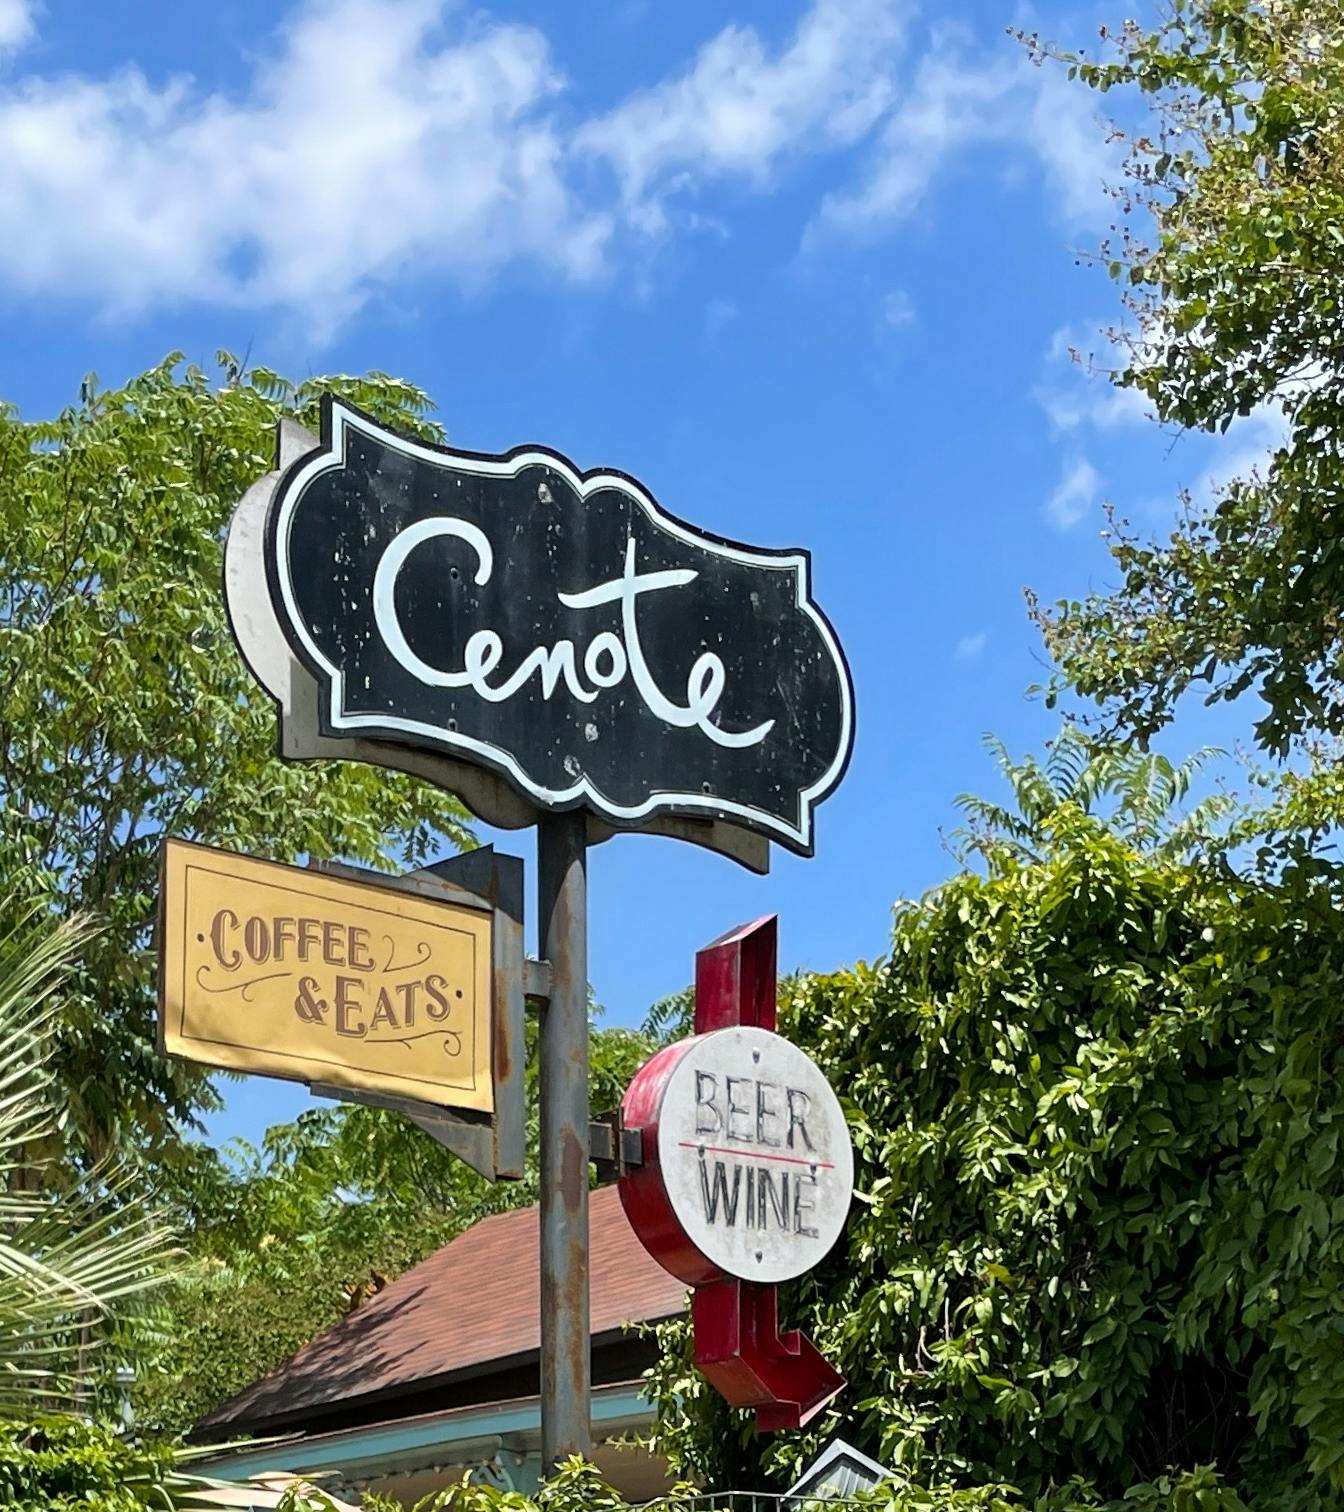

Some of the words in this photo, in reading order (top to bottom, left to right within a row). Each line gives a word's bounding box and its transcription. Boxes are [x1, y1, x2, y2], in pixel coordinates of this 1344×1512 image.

[373, 516, 775, 748] Cenote
[210, 908, 376, 972] COFFEE
[694, 1069, 816, 1152] BEER
[699, 1158, 819, 1239] WINE
